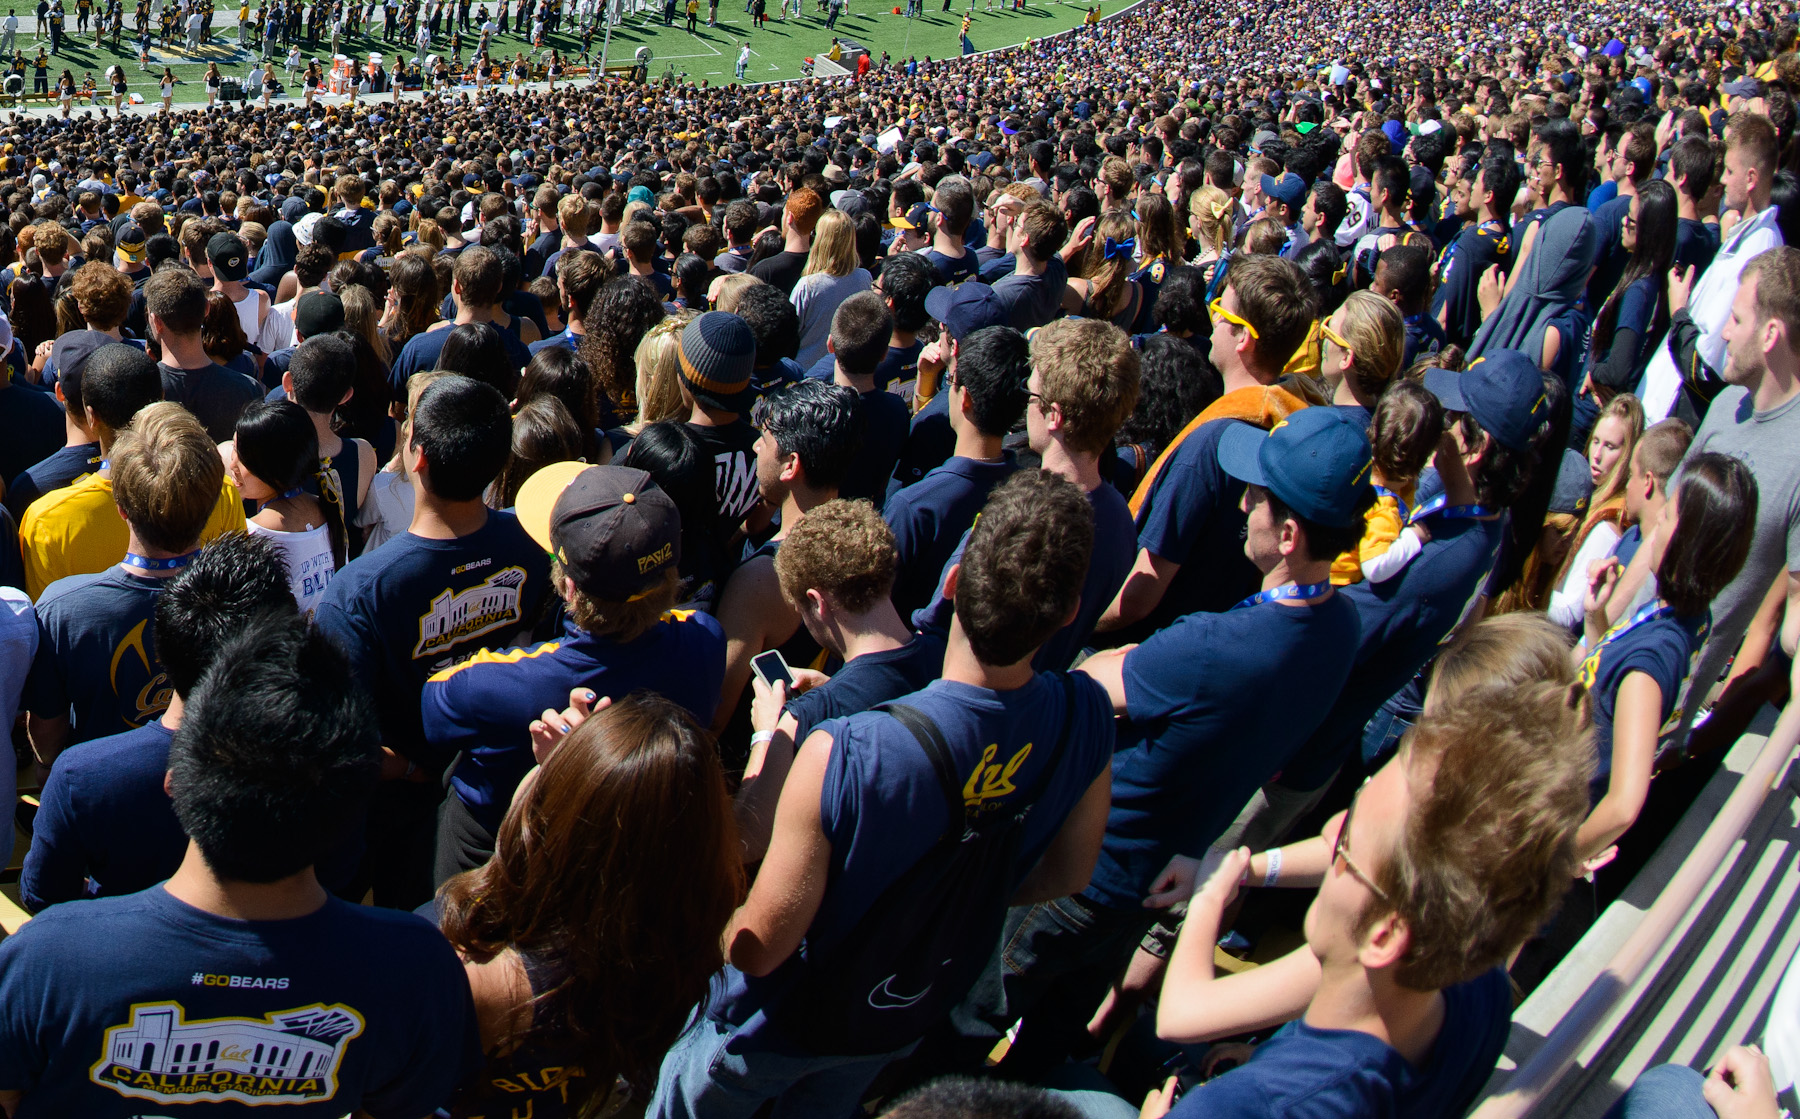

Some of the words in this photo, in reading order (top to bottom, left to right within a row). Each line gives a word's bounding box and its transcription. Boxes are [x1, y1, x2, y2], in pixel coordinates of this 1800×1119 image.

[301, 561, 310, 574] UP
[451, 558, 491, 576] #GOBEARS
[302, 568, 334, 596] BLU
[425, 609, 513, 648] CALIFORNIA
[135, 673, 174, 721] Ca
[963, 743, 1032, 807] Cal
[191, 972, 290, 990] #GOBEARS
[220, 1044, 253, 1063] Cal
[112, 1065, 318, 1092] CALIFORNIA
[143, 1082, 213, 1095] MEMORIAL
[219, 1082, 280, 1097] STADIUM
